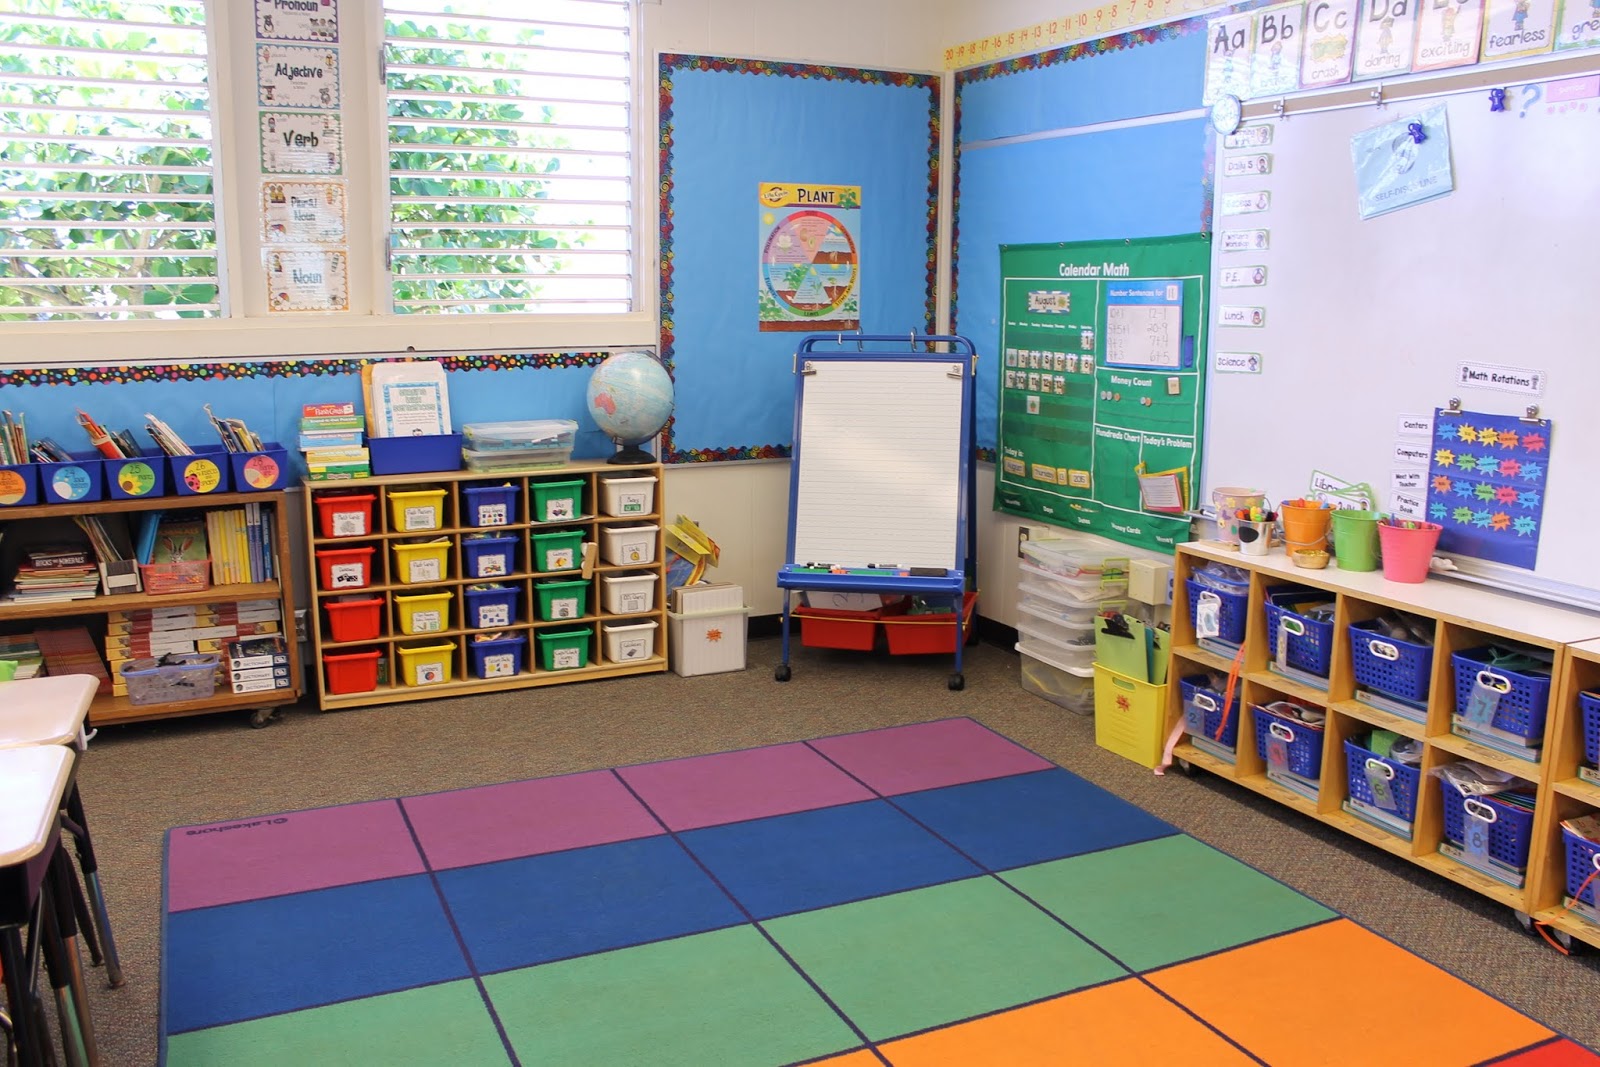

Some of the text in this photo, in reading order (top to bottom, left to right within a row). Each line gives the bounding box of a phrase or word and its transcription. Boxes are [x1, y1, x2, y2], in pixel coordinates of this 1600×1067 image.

[274, 0, 318, 12] Pronoun
[1313, 2, 1348, 32] Cc
[1261, 14, 1294, 44] Bb
[1213, 25, 1246, 53] Aa
[1489, 28, 1546, 49] fearless
[1421, 41, 1471, 59] exciting
[1364, 52, 1401, 68] daring
[274, 63, 323, 80] Adjective
[1312, 64, 1339, 80] crash
[283, 130, 319, 147] Verb
[797, 188, 835, 203] PLANT
[1375, 176, 1438, 201] SELF-DISLINE
[292, 267, 322, 284] Noun
[1059, 262, 1130, 276] Calendar Math
[1217, 357, 1246, 367] Science
[1111, 375, 1152, 387] Money Count
[1469, 371, 1530, 387] Math Rotations
[1403, 421, 1428, 430] Centers
[1095, 427, 1141, 443] Hundreds Chart
[1143, 435, 1192, 449] Today's Problem
[1397, 448, 1428, 459] Computers
[1399, 505, 1414, 514] Book
[1477, 702, 1487, 715] 7
[1189, 712, 1197, 724] 2
[1374, 783, 1385, 796] 6
[187, 821, 272, 836] Lakeshore
[1472, 832, 1482, 848] 8
